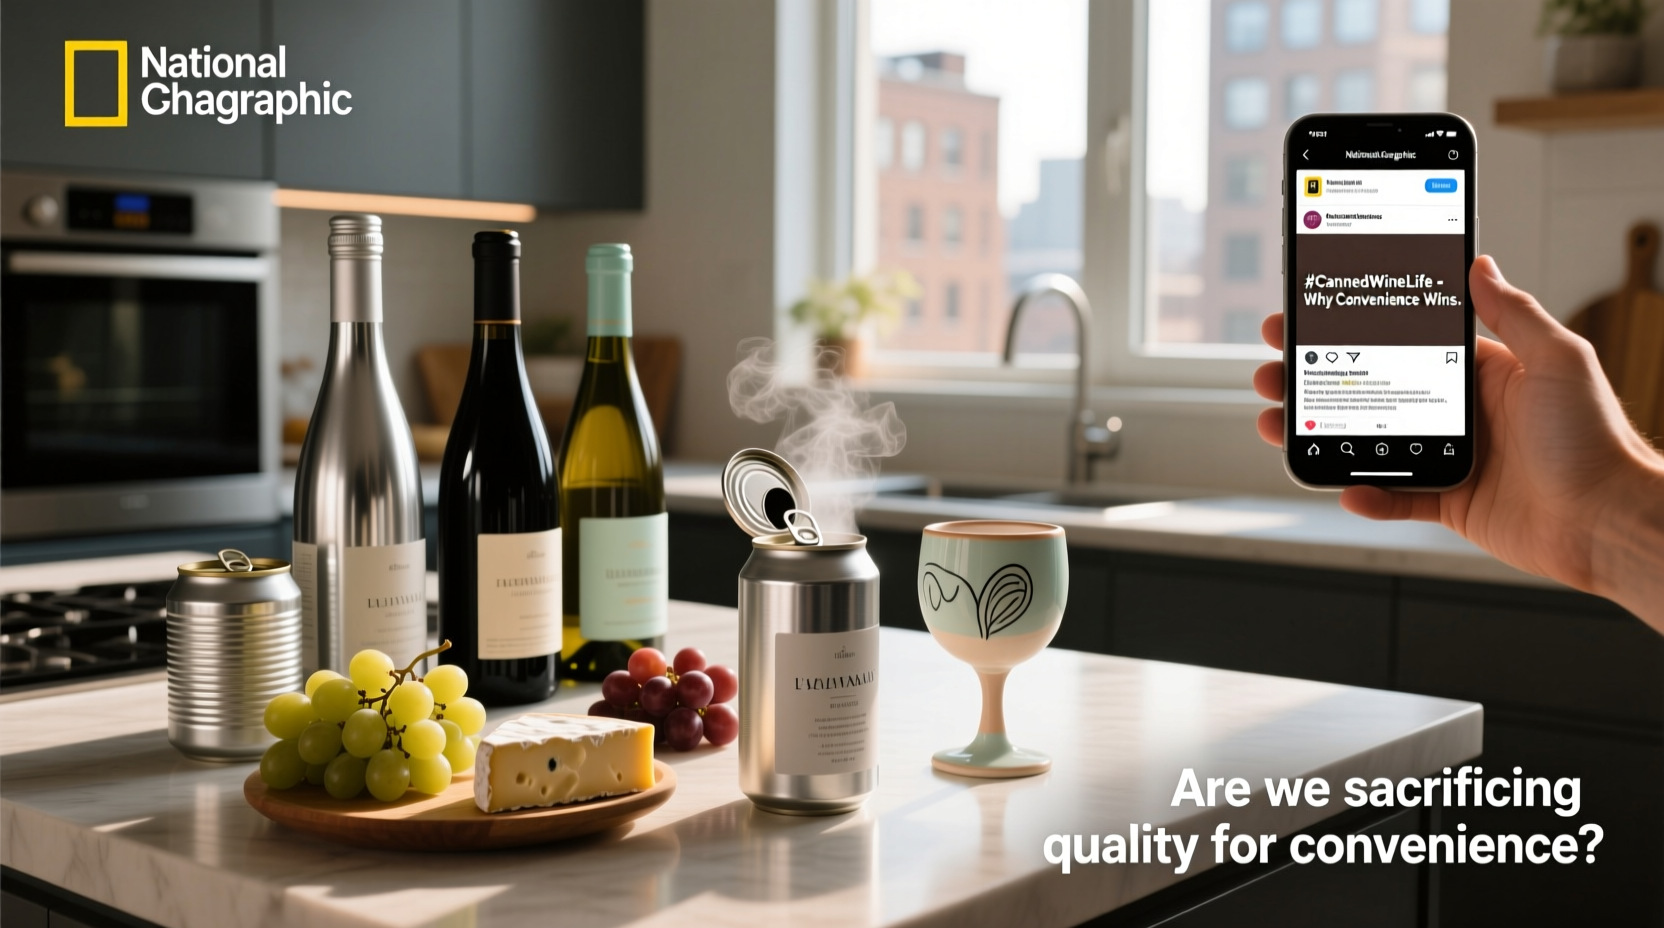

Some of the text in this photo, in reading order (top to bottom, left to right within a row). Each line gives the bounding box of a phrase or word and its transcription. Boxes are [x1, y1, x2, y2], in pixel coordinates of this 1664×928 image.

[1304, 273, 1433, 289] #CannedWineLife
[1303, 291, 1462, 309] Why Convenience Wins.
